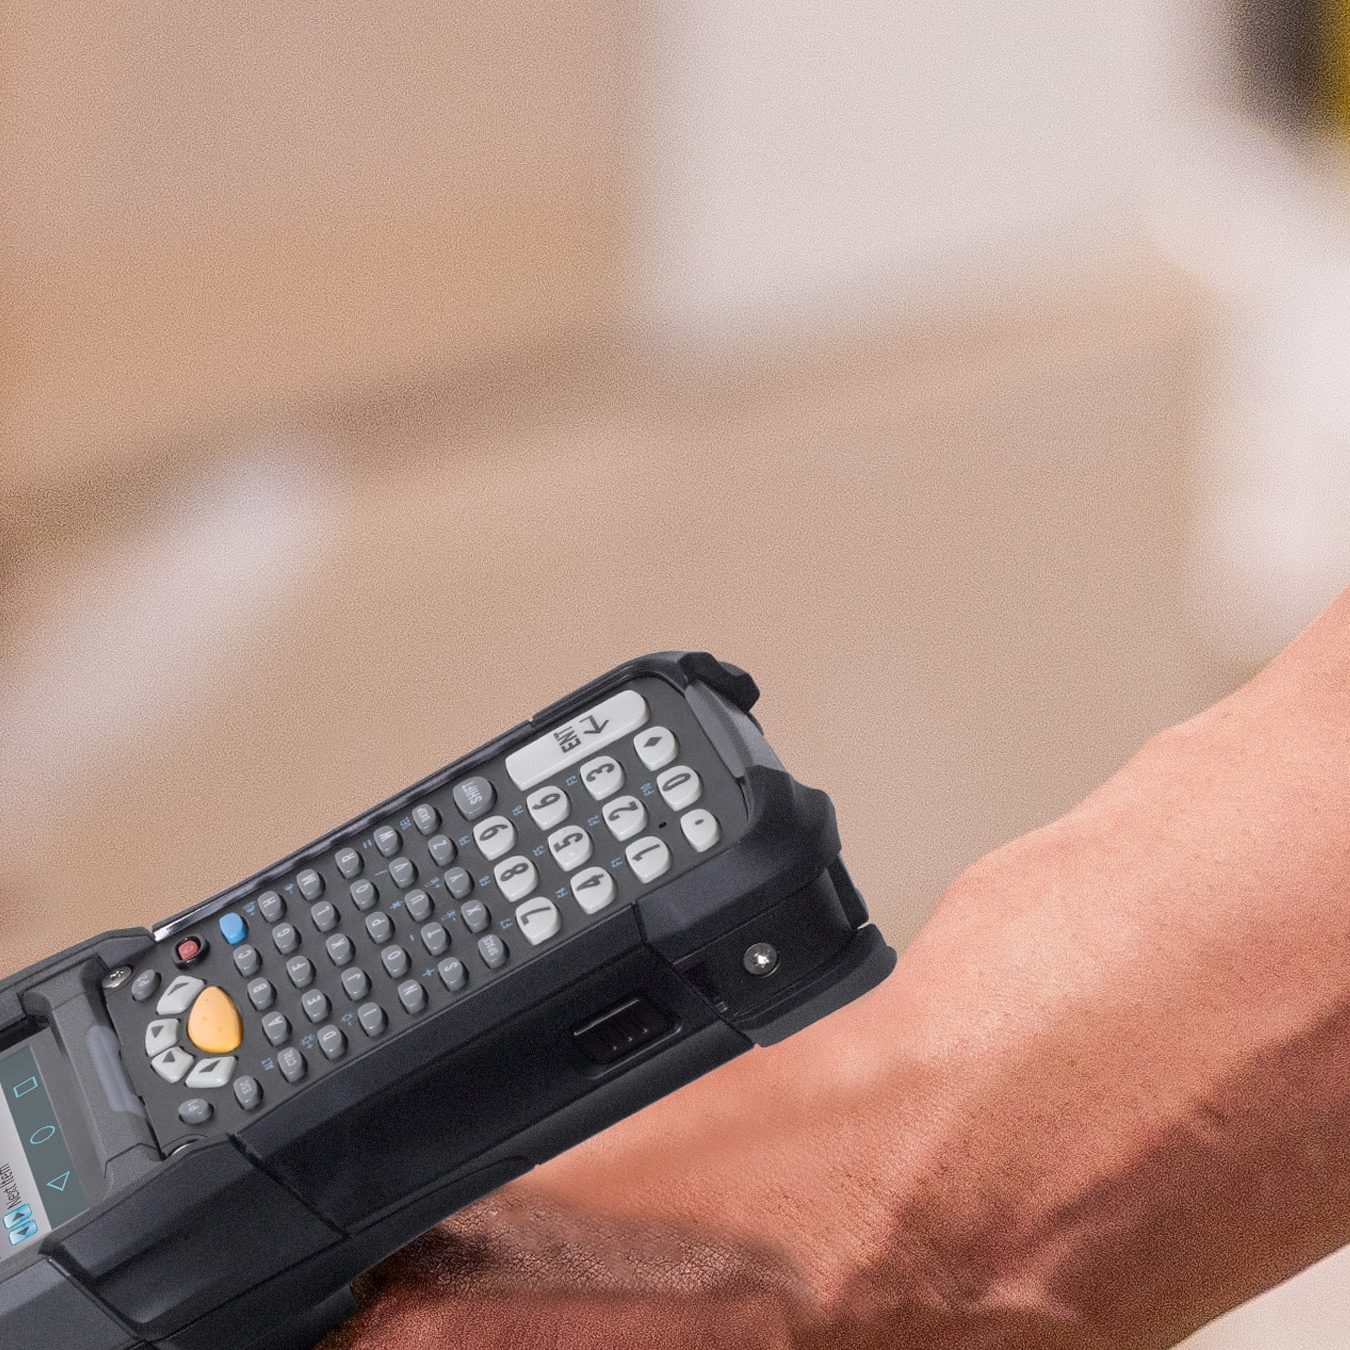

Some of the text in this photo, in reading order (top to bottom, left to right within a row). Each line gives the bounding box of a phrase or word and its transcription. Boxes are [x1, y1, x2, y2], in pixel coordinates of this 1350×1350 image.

[554, 726, 581, 753] ENT
[586, 763, 615, 782] 3
[565, 775, 578, 786] F3
[663, 773, 691, 791] 0
[462, 782, 482, 804] SHIFT
[639, 781, 656, 797] F10
[533, 793, 561, 809] 6
[510, 804, 524, 815] F6
[608, 801, 638, 821] 2
[399, 817, 411, 830] DEL
[586, 815, 600, 826] F2
[379, 831, 393, 842] W
[480, 824, 508, 841] 9
[433, 840, 447, 850] Z
[457, 834, 470, 846] F9
[554, 833, 583, 852] 5
[532, 845, 545, 856] F5
[632, 844, 660, 861] 1
[342, 853, 354, 863] R
[610, 856, 623, 868] F1
[394, 863, 408, 872] V
[501, 863, 529, 881] 8
[302, 874, 316, 885] M
[449, 874, 463, 883] Y
[477, 875, 490, 887] F8
[576, 874, 604, 891] 4
[356, 884, 369, 893] Q
[556, 886, 567, 898] F4
[263, 897, 276, 907] H
[411, 895, 424, 905] U
[317, 906, 330, 916] L
[466, 905, 481, 916] X
[520, 906, 551, 925] 7
[372, 919, 384, 927] P
[500, 918, 513, 929] F7
[277, 928, 290, 937] G
[427, 929, 441, 938] T
[332, 939, 343, 949] K
[482, 936, 498, 956] SPACE
[238, 950, 252, 959] C
[388, 951, 401, 960] O
[292, 963, 305, 971] F
[444, 962, 458, 971] S
[137, 975, 149, 987] P2
[347, 972, 361, 981] J
[253, 984, 267, 993] B
[404, 984, 417, 995] N
[307, 995, 321, 1005] E
[268, 1016, 282, 1027] A
[323, 1031, 336, 1041] D
[283, 1049, 297, 1066] CTRL
[261, 1058, 274, 1072] ALT
[240, 1080, 252, 1094] ESC
[187, 1100, 199, 1112] P1
[3, 1183, 22, 1210] Next
